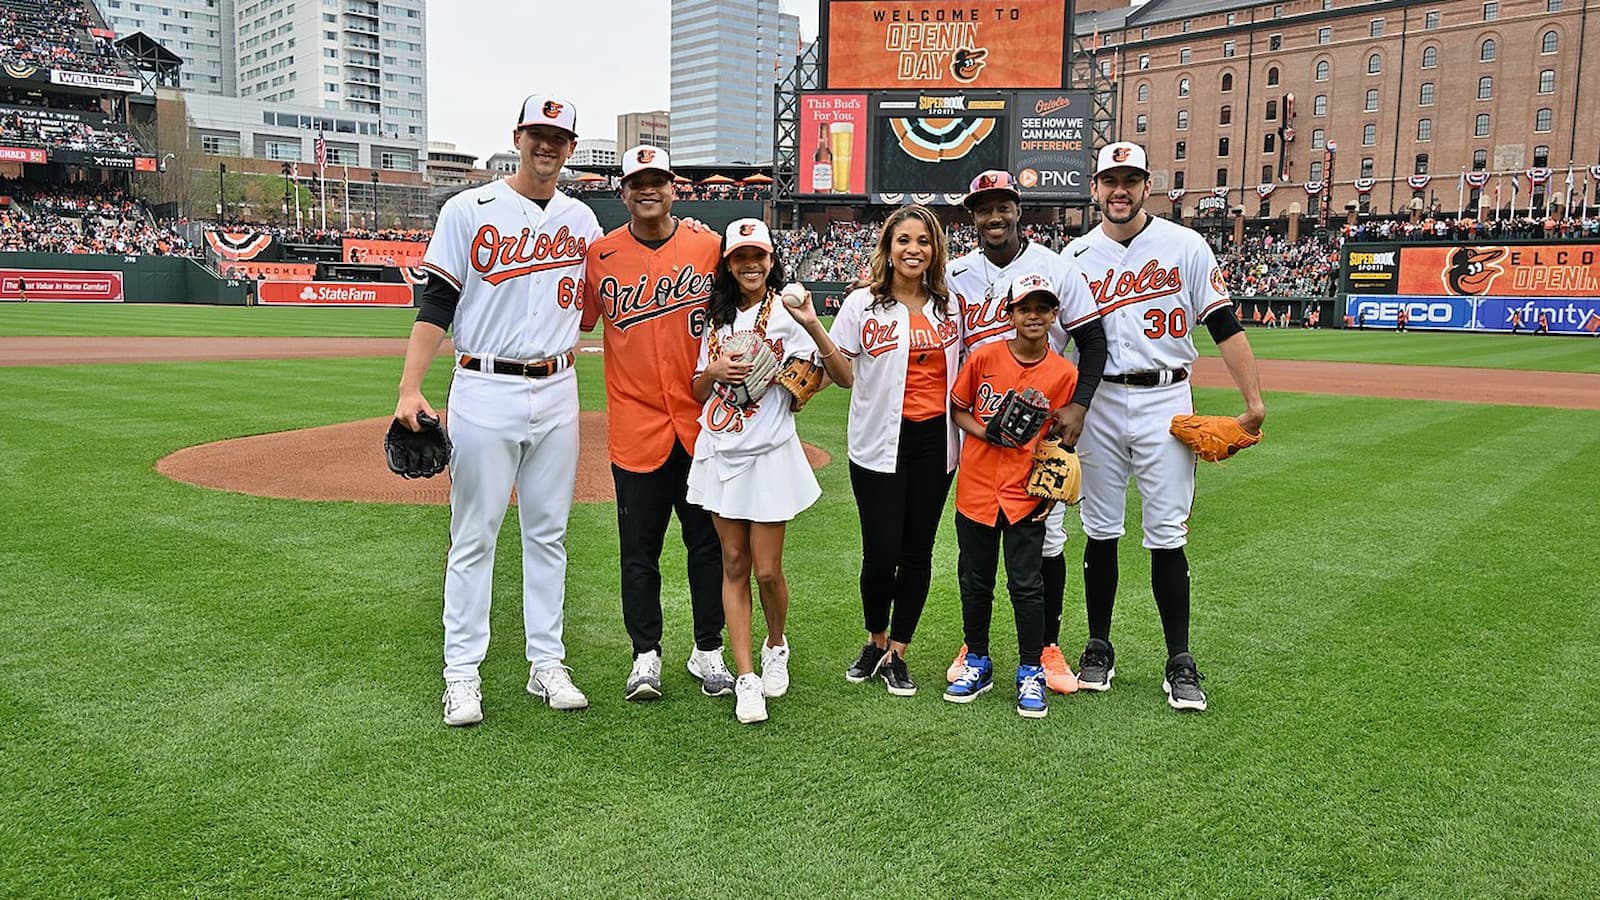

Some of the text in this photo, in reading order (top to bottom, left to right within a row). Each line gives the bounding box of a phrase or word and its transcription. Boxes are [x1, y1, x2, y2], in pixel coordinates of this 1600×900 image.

[873, 9, 1020, 22] WELCOME TO
[898, 52, 950, 80] DAY
[61, 72, 98, 85] WBAL
[808, 98, 860, 109] This Bud's
[919, 95, 965, 110] SUPERBOOK
[813, 111, 855, 120] For You.
[1021, 117, 1084, 128] SEE HOW WE
[1021, 129, 1082, 139] CAN MAKE A
[1020, 140, 1082, 151] DIFFERENCE
[1040, 170, 1080, 186] PNC
[1199, 197, 1226, 210] BOOGS
[470, 224, 586, 274] Orioles
[1349, 251, 1396, 266] SUPERBOOK
[6, 282, 18, 290] The
[1082, 259, 1182, 304] rioles
[557, 276, 586, 310] 68
[600, 265, 718, 320] Orioles
[1506, 301, 1595, 329] xfinity
[1144, 308, 1187, 339] 30
